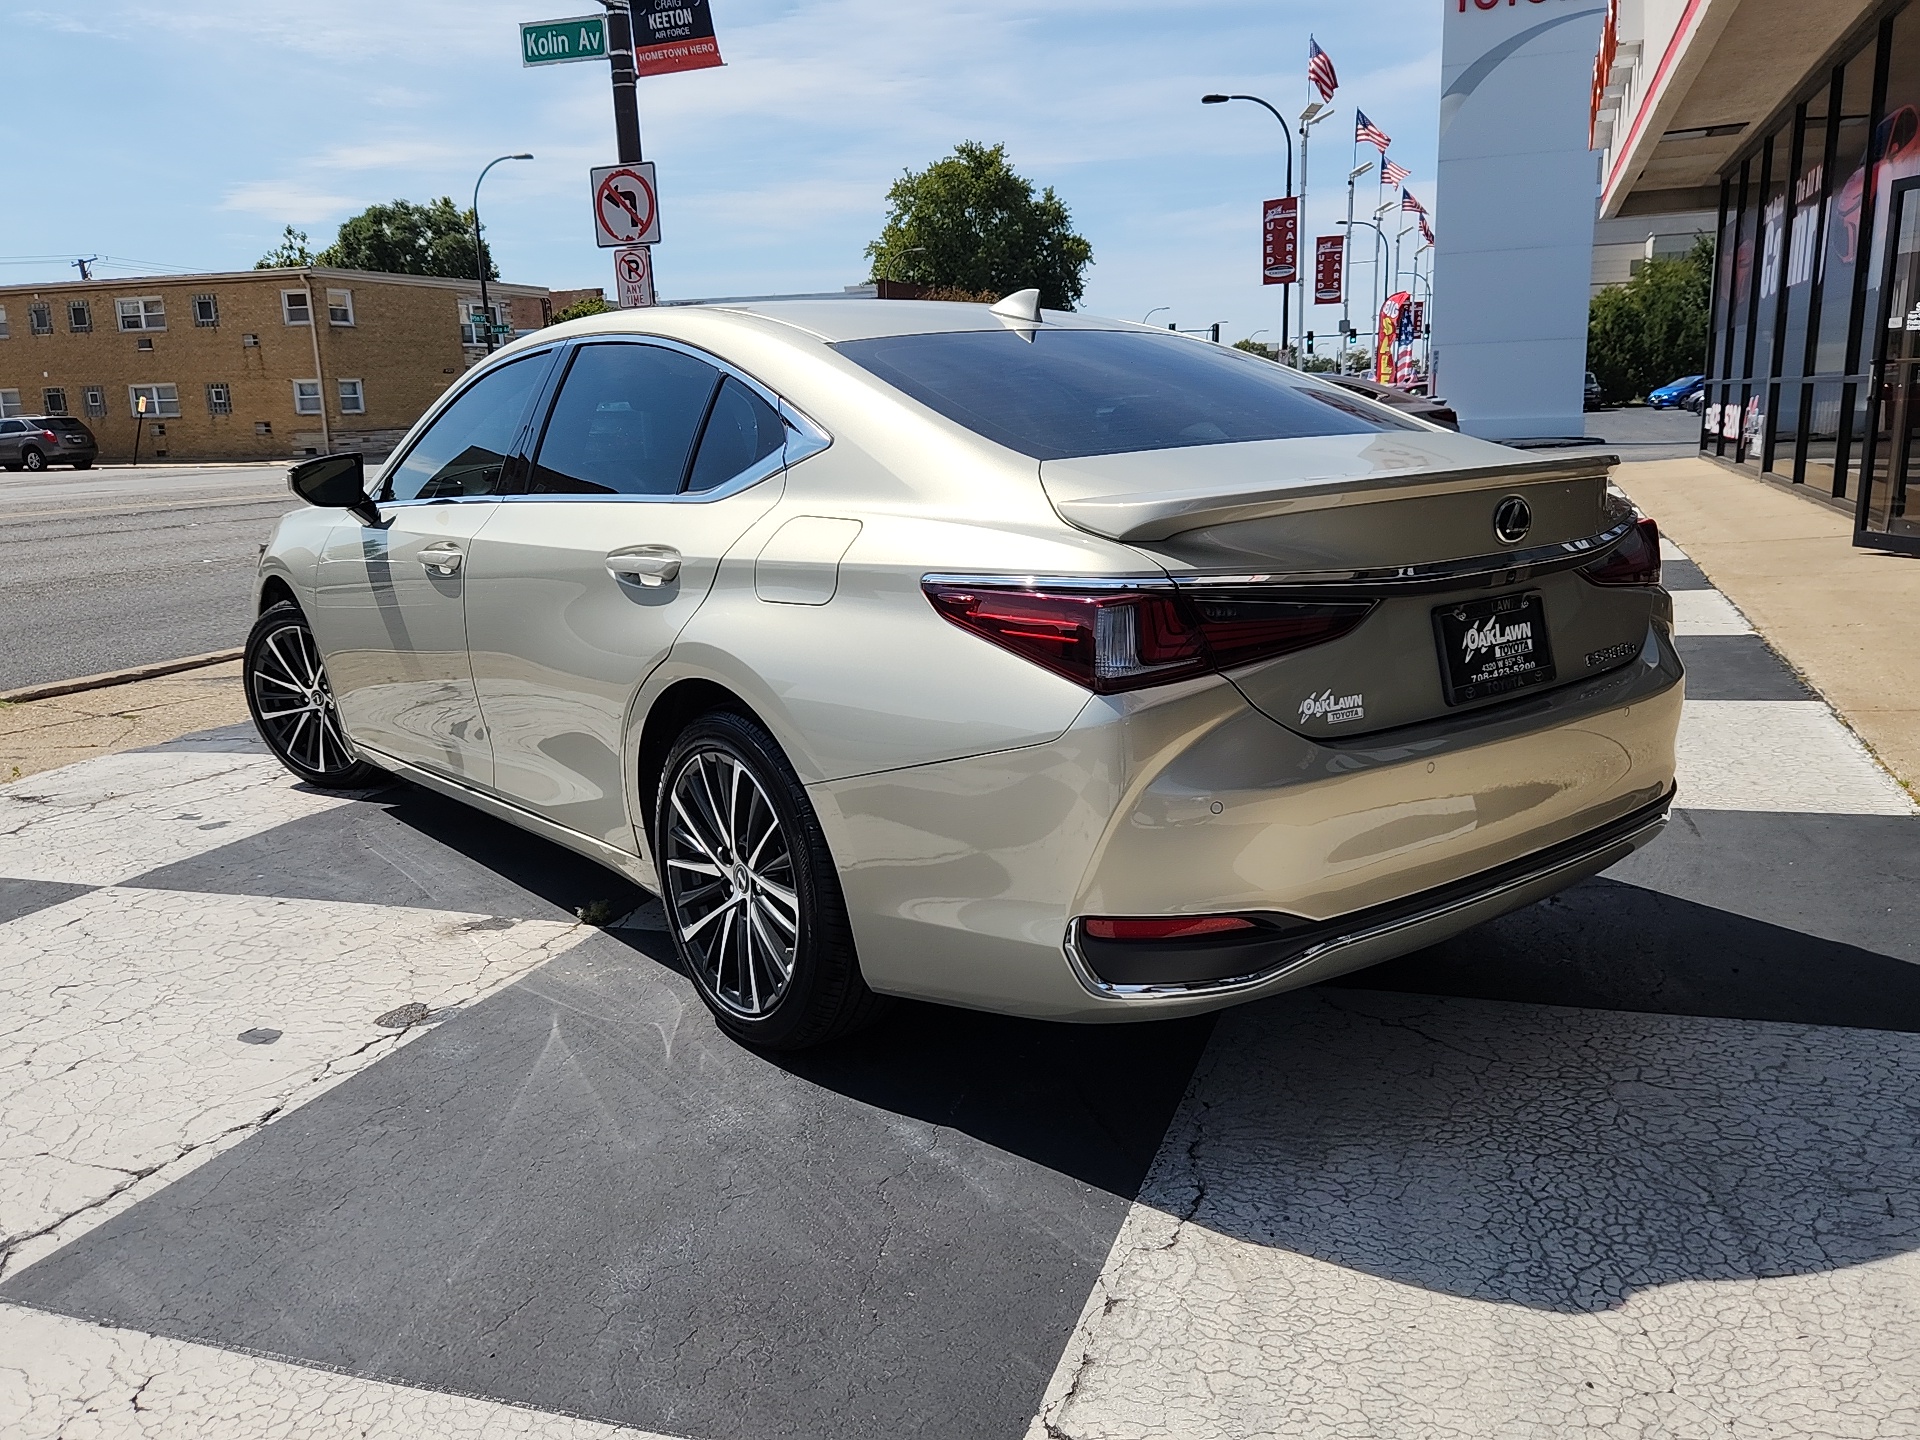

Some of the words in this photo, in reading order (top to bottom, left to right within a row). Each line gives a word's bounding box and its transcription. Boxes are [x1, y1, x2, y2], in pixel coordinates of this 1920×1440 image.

[654, 0, 682, 10] CRAIG
[648, 8, 692, 30] KEETON
[655, 30, 667, 39] AIR
[667, 27, 690, 38] FORCE
[526, 31, 569, 57] Kolin
[578, 28, 600, 51] Av
[639, 47, 689, 62] HOMETOWN
[690, 43, 715, 56] HERO
[1266, 222, 1274, 265] USED
[1285, 220, 1295, 263] CARS
[1317, 254, 1325, 289] USED
[1333, 254, 1341, 288] CARS
[626, 284, 642, 295] ANY
[626, 295, 645, 304] TIME
[1383, 300, 1399, 318] BIG
[1380, 317, 1393, 384] SALE
[1490, 598, 1515, 612] LAW
[1499, 641, 1530, 656] TOYOTA
[1470, 661, 1536, 683] 708-423-5200
[1481, 661, 1497, 672] 4320
[1496, 660, 1504, 668] W
[1516, 655, 1525, 664] St
[1331, 708, 1360, 721] TOYOTA
